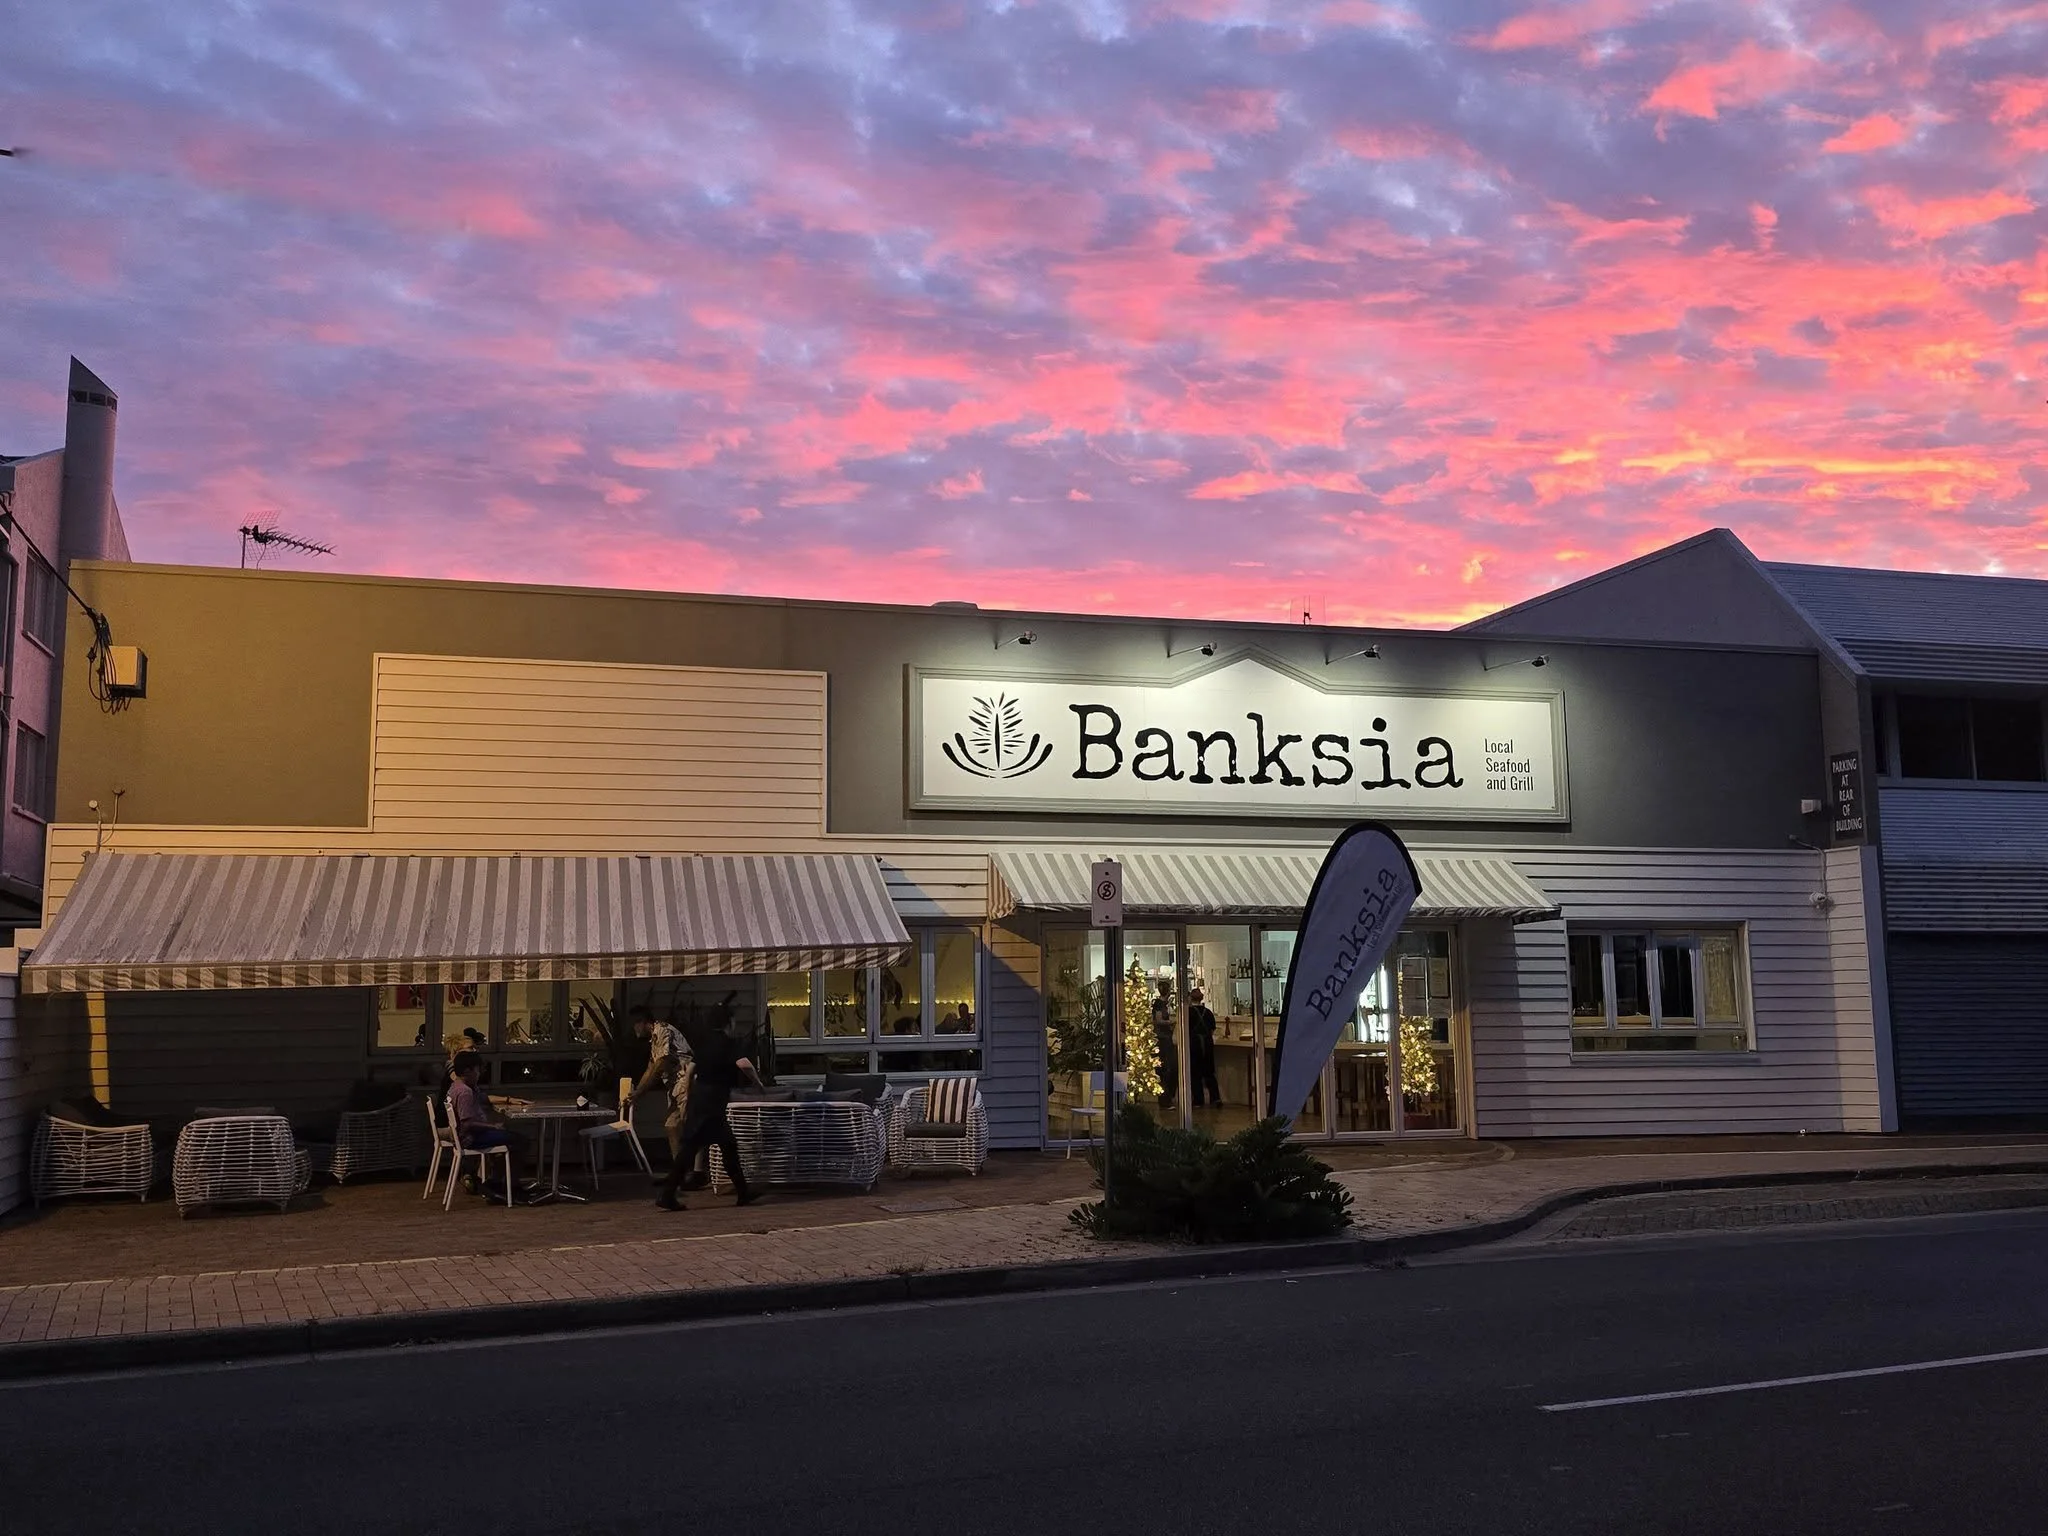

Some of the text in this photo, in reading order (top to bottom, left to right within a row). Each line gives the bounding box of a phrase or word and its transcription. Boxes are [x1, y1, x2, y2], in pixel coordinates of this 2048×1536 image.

[1069, 703, 1464, 790] Banksia
[1484, 738, 1514, 754] Local
[1485, 757, 1530, 773] Seafood
[1832, 758, 1857, 773] PARKING
[1486, 775, 1534, 792] and Grill
[1841, 774, 1849, 787] AT
[1839, 789, 1854, 801] REAR
[1842, 804, 1850, 816] OF
[1836, 817, 1862, 832] BUILDING
[1306, 867, 1398, 1021] Banksia
